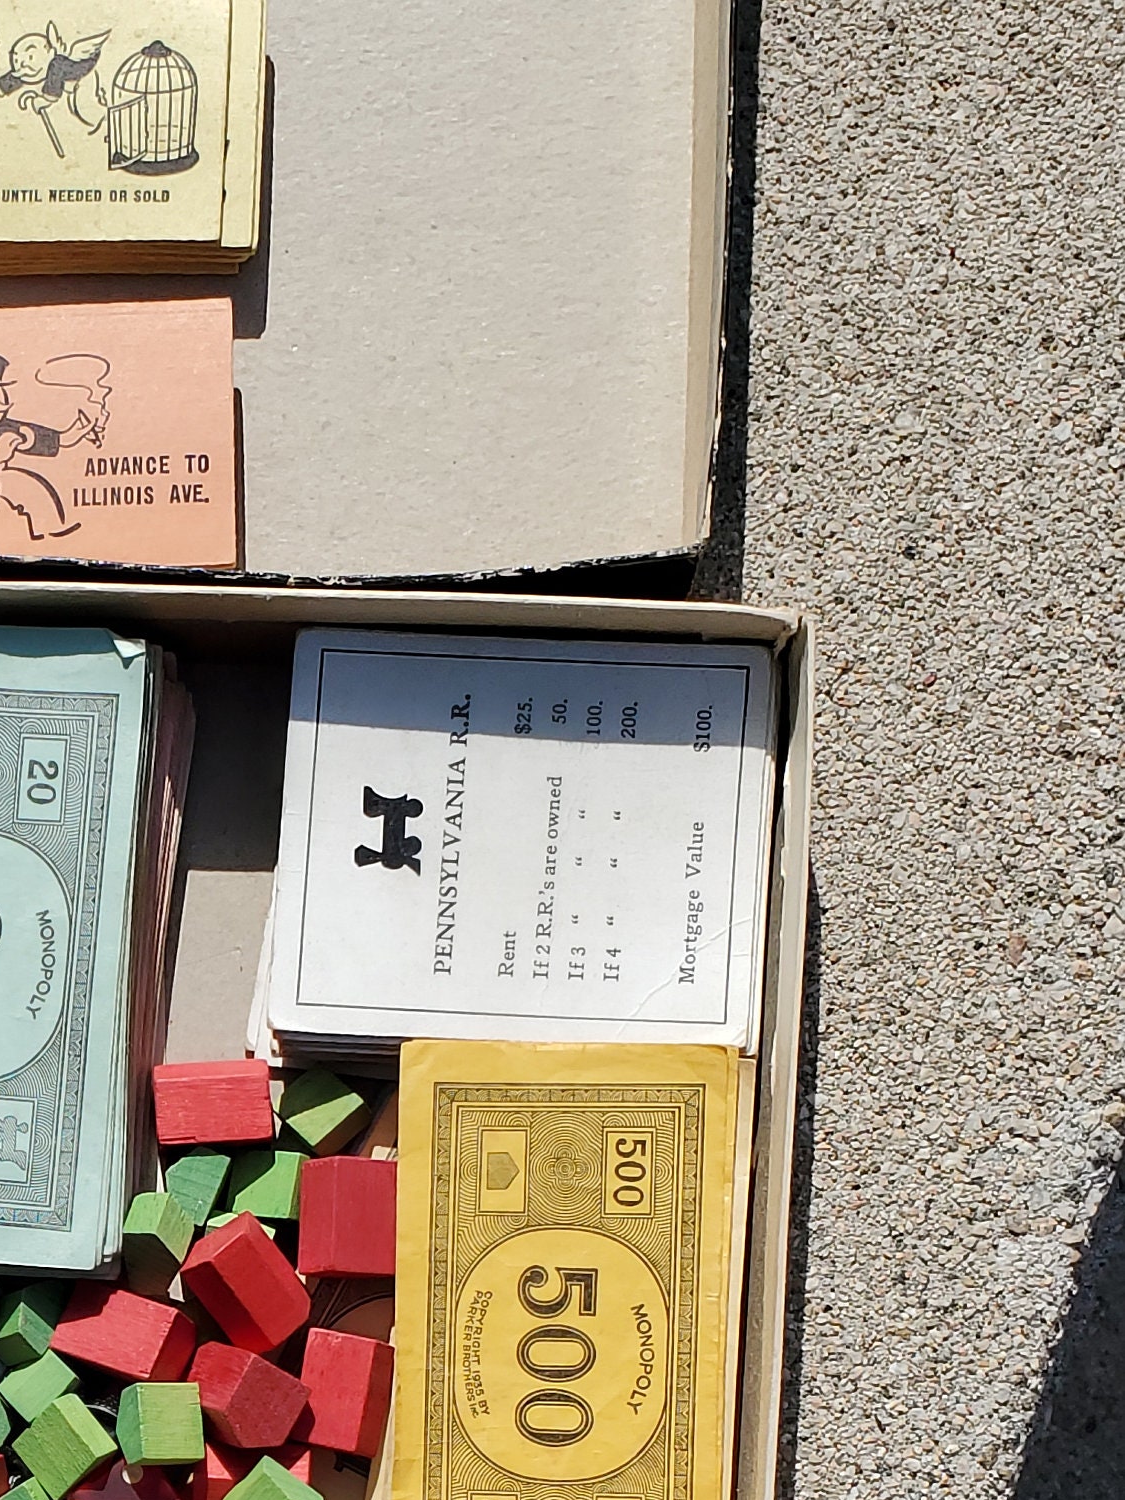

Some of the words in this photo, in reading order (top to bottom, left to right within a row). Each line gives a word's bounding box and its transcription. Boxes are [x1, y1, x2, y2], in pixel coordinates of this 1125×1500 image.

[2, 189, 42, 203] UNTIL
[49, 189, 102, 203] NEEDED
[109, 189, 128, 203] OR
[134, 189, 170, 203] SOLD
[85, 455, 171, 477] ADVANCE
[185, 454, 210, 474] TO
[74, 486, 154, 508] ILLINOIS
[169, 484, 210, 504] AVE.
[552, 699, 568, 724] 50.
[587, 700, 603, 735] 100.
[621, 701, 638, 738] 200.
[693, 705, 713, 752] $100.
[25, 759, 59, 806] 20
[547, 776, 562, 839] owned
[434, 757, 466, 975] PENNSYLVANIA
[450, 694, 472, 747] R.R.
[498, 931, 517, 977] Rent
[514, 697, 533, 734] $25.
[686, 822, 704, 879] Value
[545, 845, 557, 875] are
[536, 944, 550, 955] 2
[571, 947, 585, 956] 3
[606, 948, 621, 957] 4
[679, 890, 703, 984] Mortgage
[25, 909, 56, 1020] MONOPOLY
[533, 960, 549, 979] If
[568, 961, 584, 980] If
[603, 962, 619, 981] If
[614, 1138, 646, 1207] 500
[463, 1290, 483, 1342] PARKER
[472, 1291, 492, 1365] COPYRIGHT
[463, 1344, 476, 1401] BROTHERS
[515, 1265, 598, 1447] 500
[627, 1304, 655, 1415] MONOPOLY
[472, 1370, 484, 1396] 1935
[479, 1399, 490, 1415] BY
